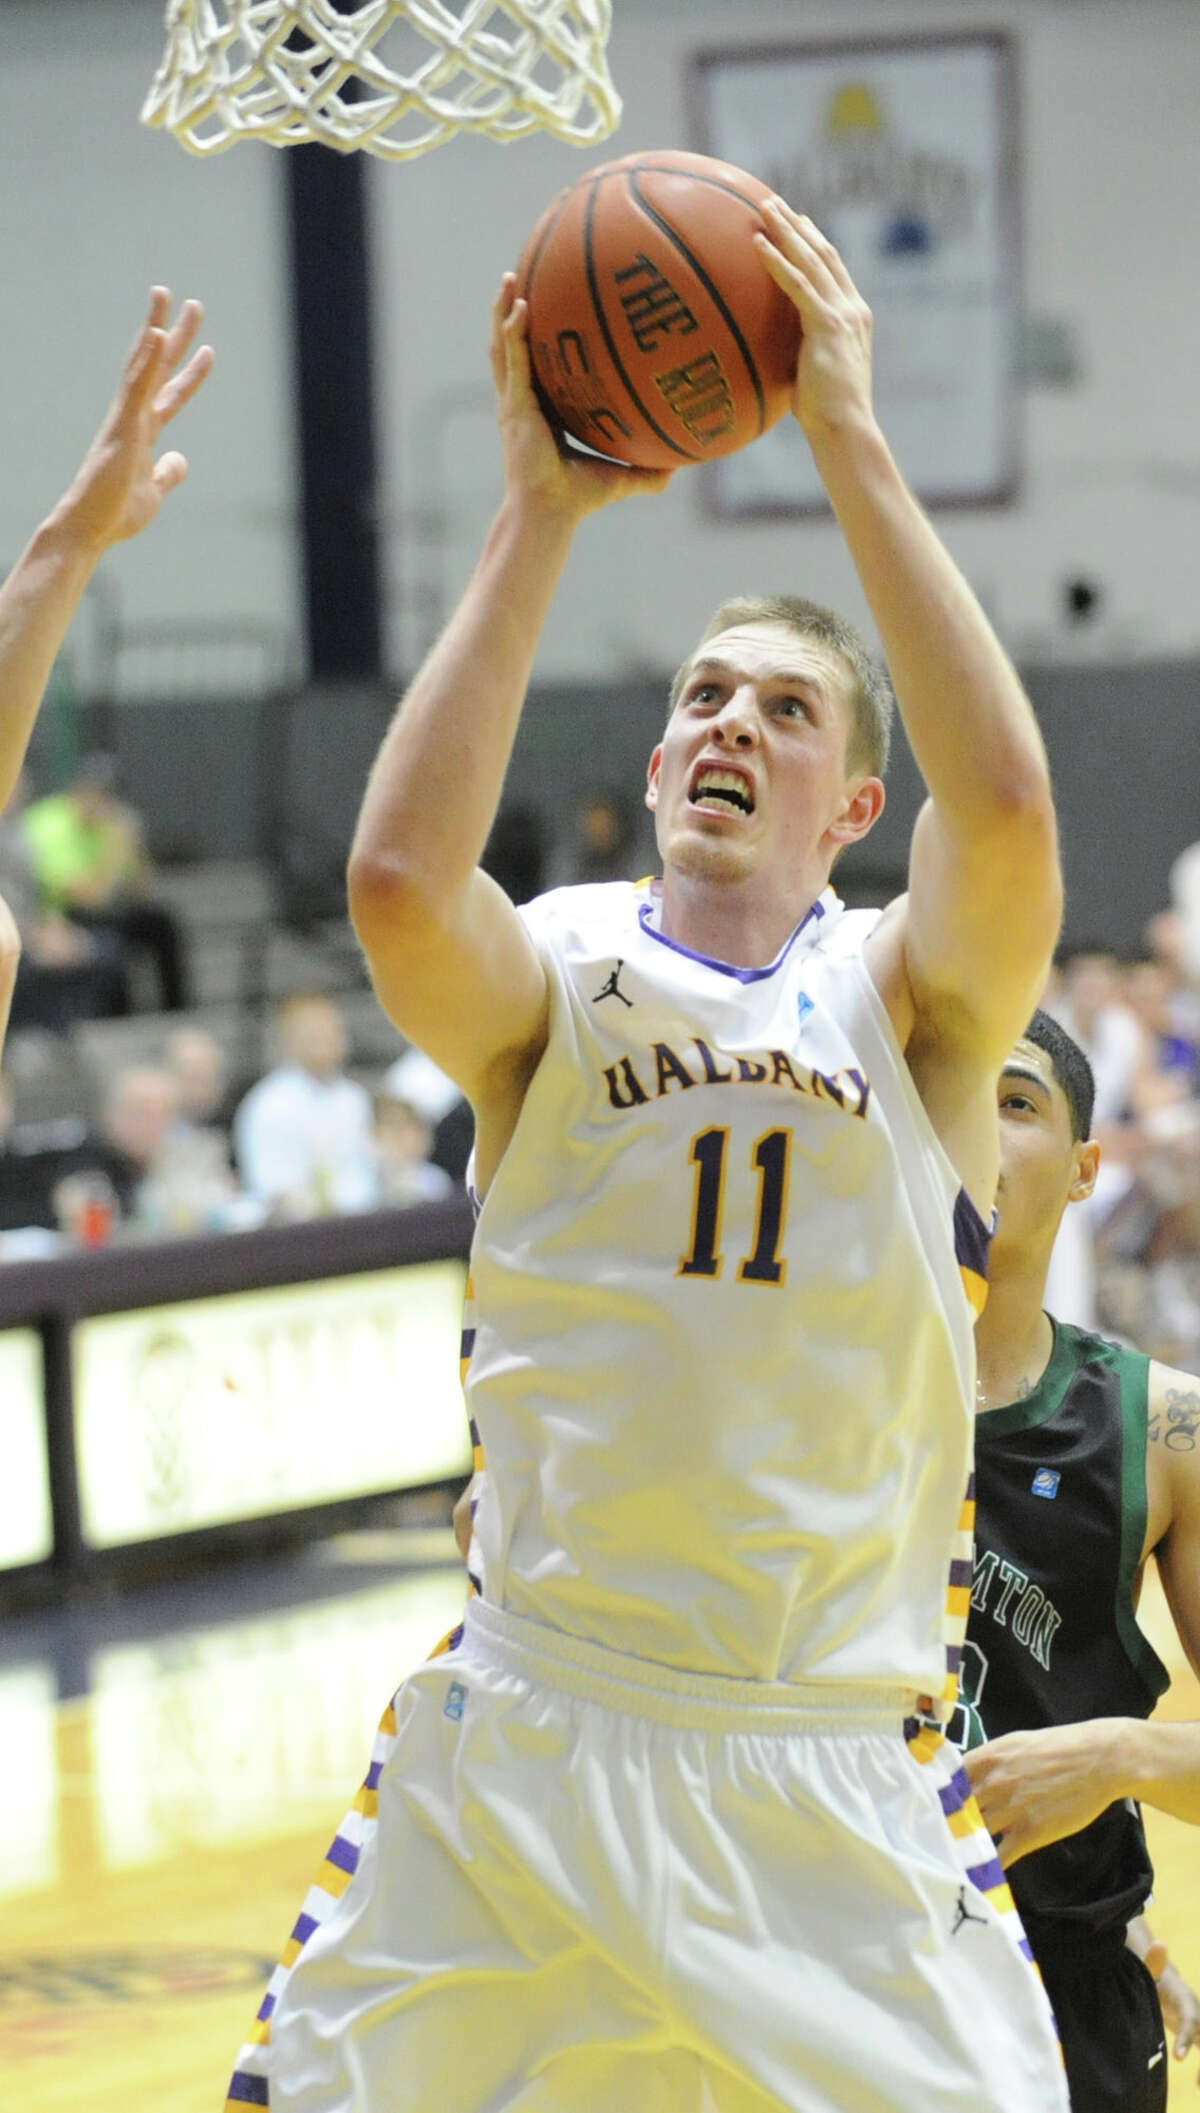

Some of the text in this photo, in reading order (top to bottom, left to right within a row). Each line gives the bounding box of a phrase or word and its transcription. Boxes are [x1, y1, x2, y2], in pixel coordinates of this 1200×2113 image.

[613, 252, 698, 353] THE
[602, 1037, 870, 1120] UALBANY
[674, 1124, 794, 1288] 11
